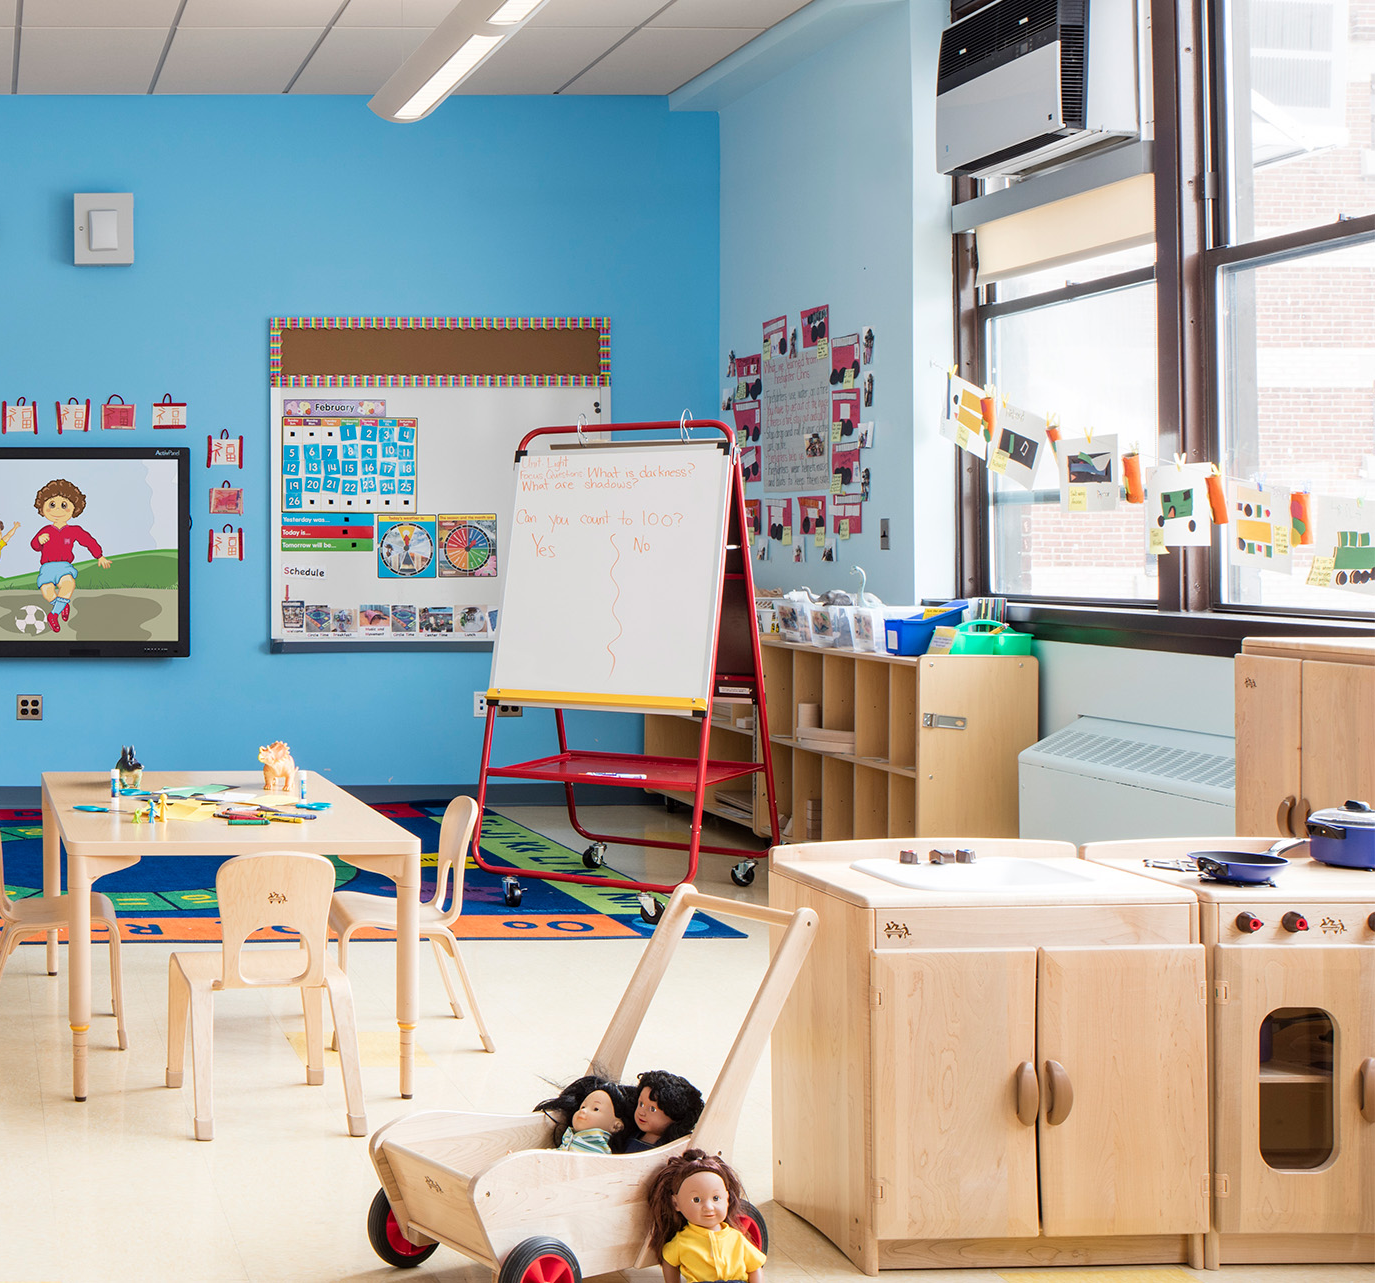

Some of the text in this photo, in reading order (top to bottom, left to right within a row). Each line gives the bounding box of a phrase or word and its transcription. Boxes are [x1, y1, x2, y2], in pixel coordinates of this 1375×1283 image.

[315, 403, 355, 412] February
[366, 430, 372, 438] 2
[384, 431, 389, 439] 3
[403, 430, 409, 439] 4
[289, 446, 409, 457] 5 6 7 8 9 10 11
[546, 457, 569, 468] Light
[287, 463, 412, 474] 12 13 14 15 16 17 18
[520, 471, 544, 480] Focus
[587, 466, 621, 479] What
[625, 467, 635, 478] is
[639, 462, 696, 479] darkness?
[290, 480, 412, 492] 19 20 21 22 23 24 25
[522, 477, 639, 491] What are shadows?
[289, 497, 300, 505] 26
[516, 509, 684, 532] Can you count to 100?
[531, 533, 651, 557] Yes No
[284, 567, 325, 577] Schedule
[500, 841, 551, 852] Kk
